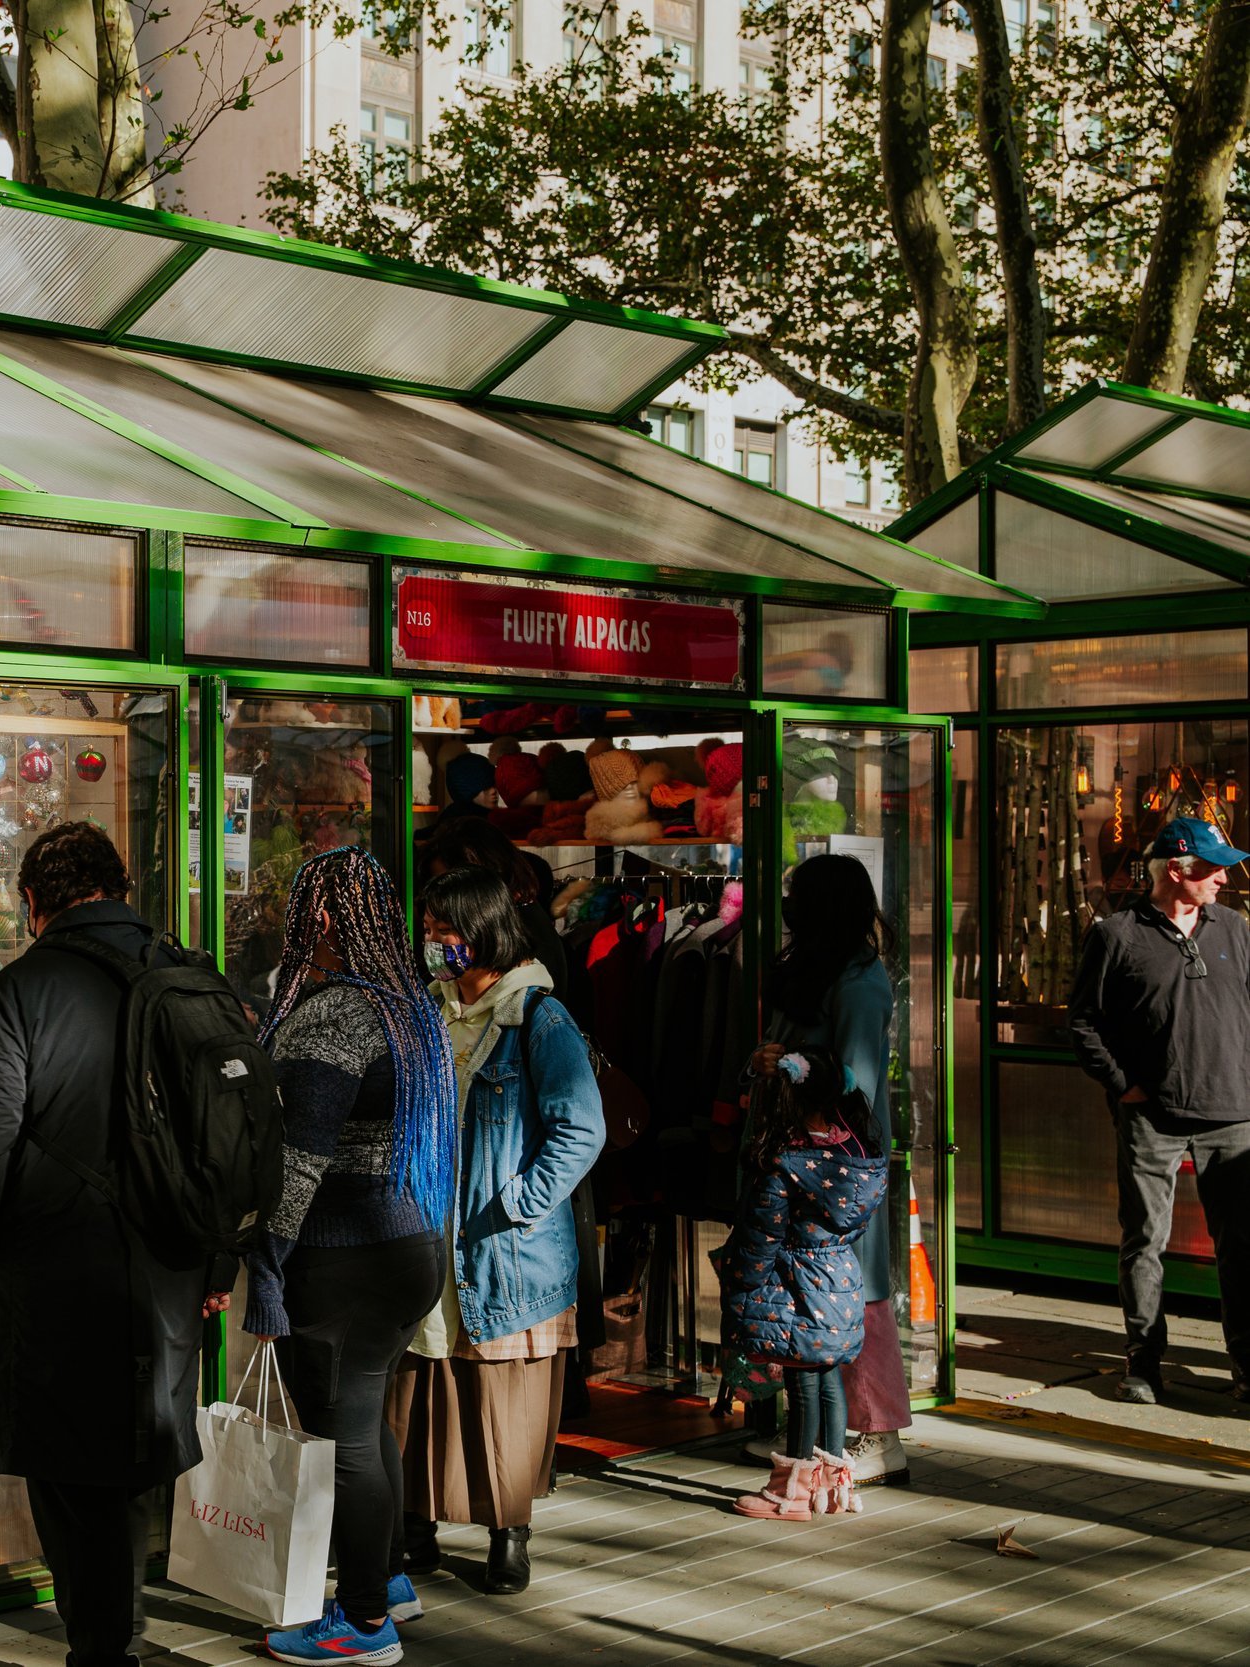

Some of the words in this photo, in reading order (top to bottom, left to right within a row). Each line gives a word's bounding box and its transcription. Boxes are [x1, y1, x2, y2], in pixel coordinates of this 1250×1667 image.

[406, 609, 432, 627] N16
[502, 607, 568, 646] FLUFFY
[573, 614, 651, 653] ALPACAS
[190, 1498, 221, 1526] LIZ
[222, 1510, 267, 1542] LISA
